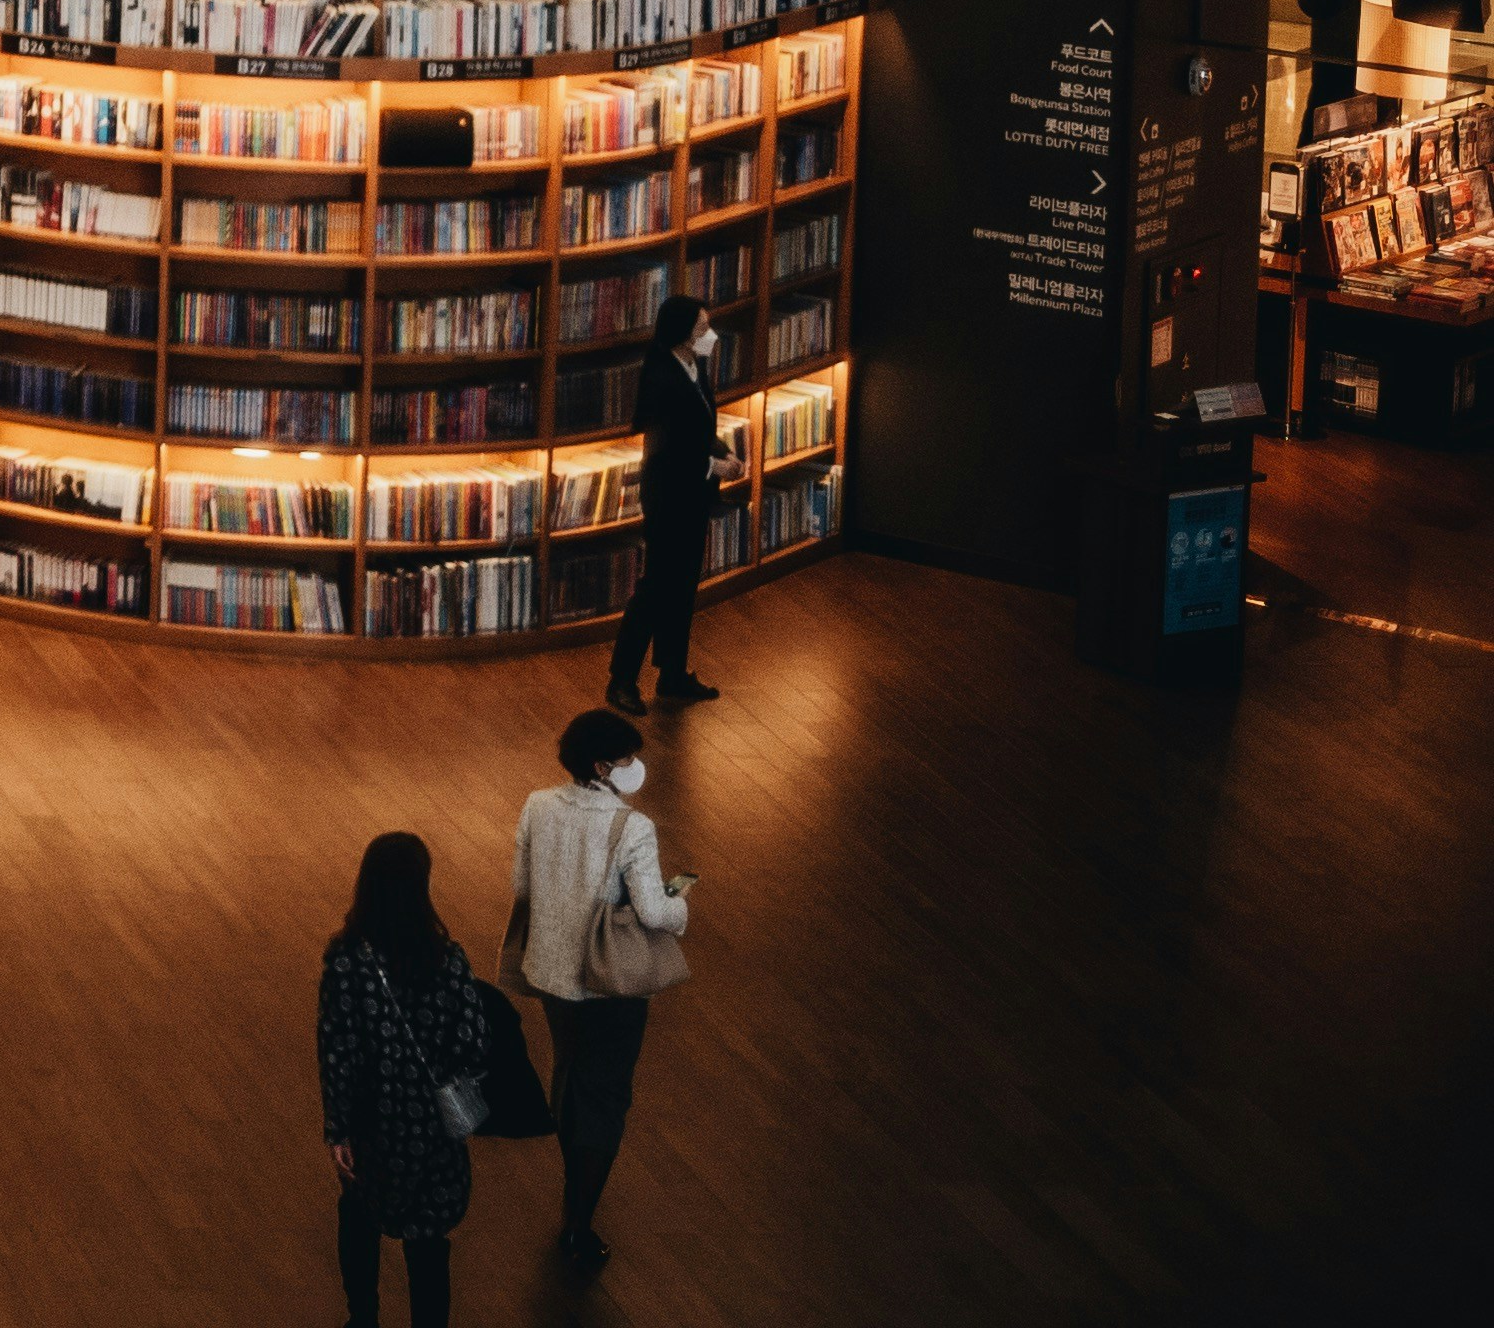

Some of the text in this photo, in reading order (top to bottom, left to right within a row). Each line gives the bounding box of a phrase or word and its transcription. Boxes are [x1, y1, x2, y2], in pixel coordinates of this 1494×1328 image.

[237, 58, 266, 75] B27
[1051, 60, 1112, 79] Food Court
[1009, 93, 1110, 117] Bongeunsa Station
[1044, 117, 1108, 142] 롯데면세점
[1004, 130, 1108, 156] LOTTE DUTY FREE
[1029, 195, 1106, 220] 라이브플라자
[1052, 216, 1104, 235] Live Plaza
[1026, 233, 1103, 258] 트레이드타워
[1035, 252, 1065, 268] Trade
[1068, 257, 1103, 274] Tower
[1008, 272, 1103, 302] 밀레니엄플라자
[1009, 290, 1102, 318] Millennium Plaza
